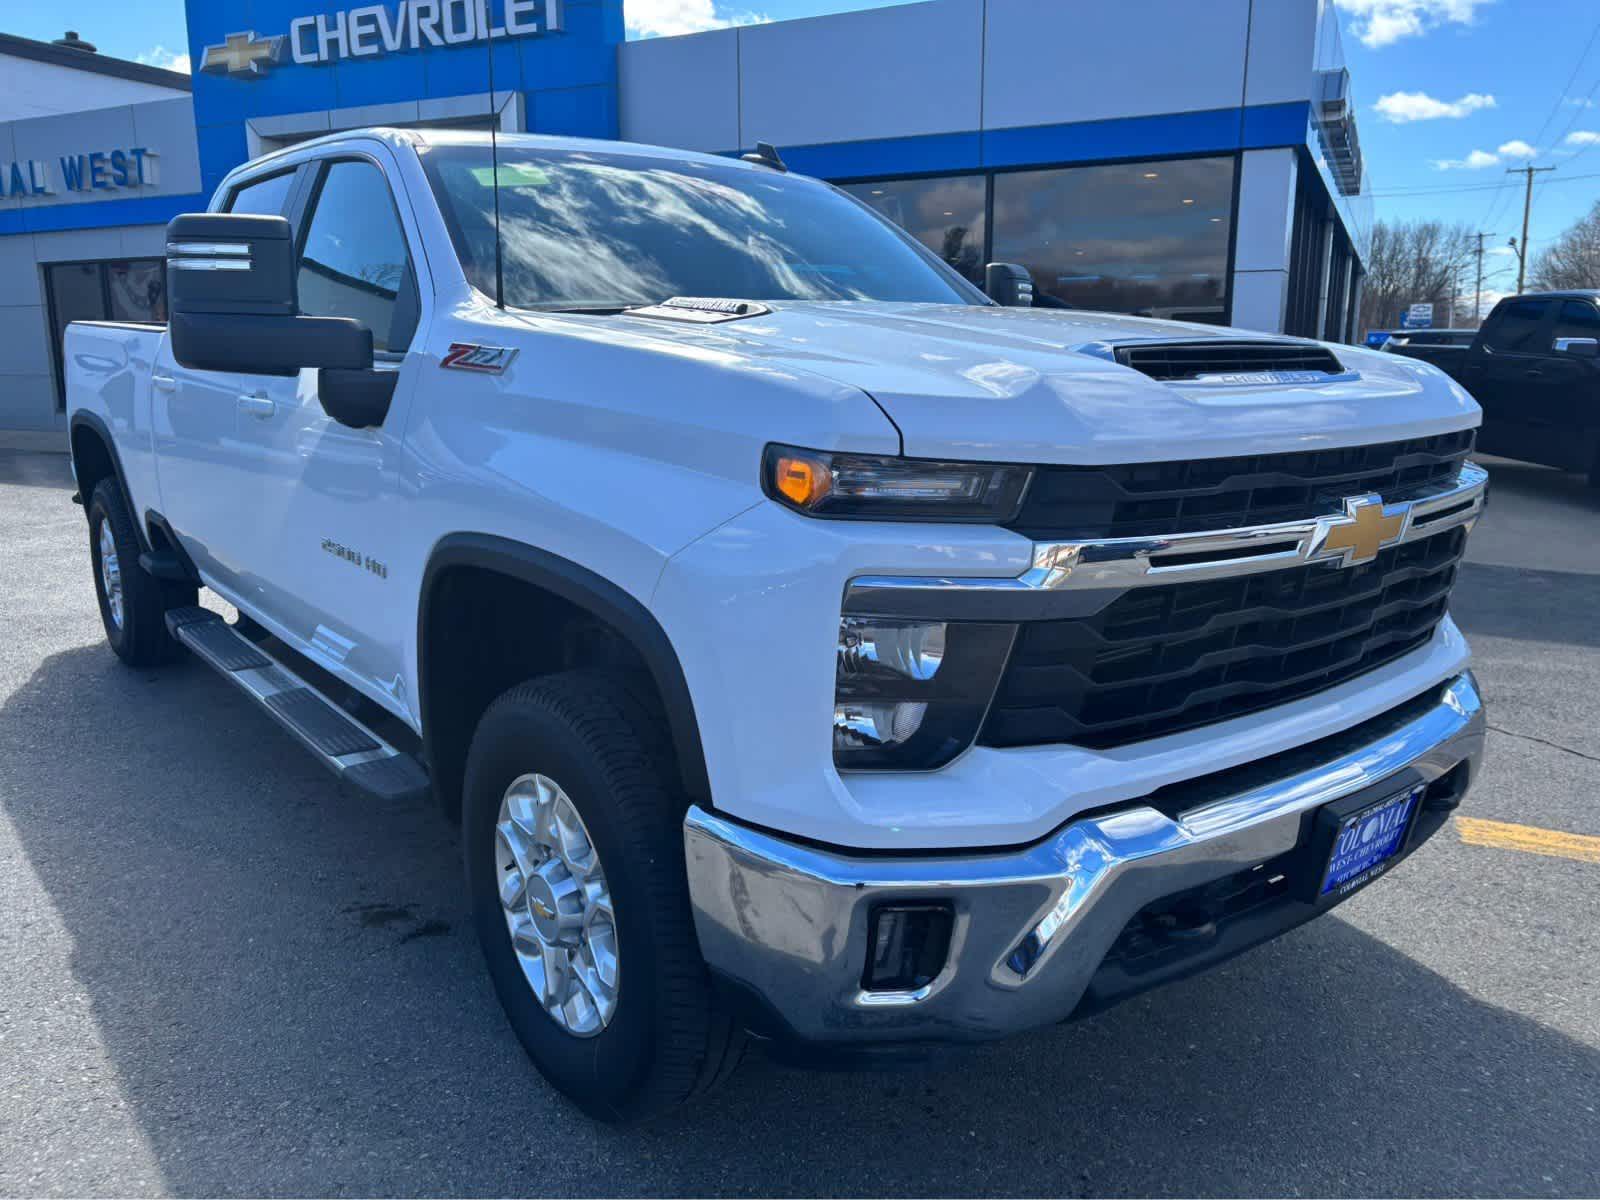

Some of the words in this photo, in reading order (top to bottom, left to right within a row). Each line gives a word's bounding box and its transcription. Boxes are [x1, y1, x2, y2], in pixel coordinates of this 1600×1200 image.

[290, 0, 558, 63] CHEVROLET
[60, 148, 147, 192] WEST
[439, 341, 520, 376] Z71
